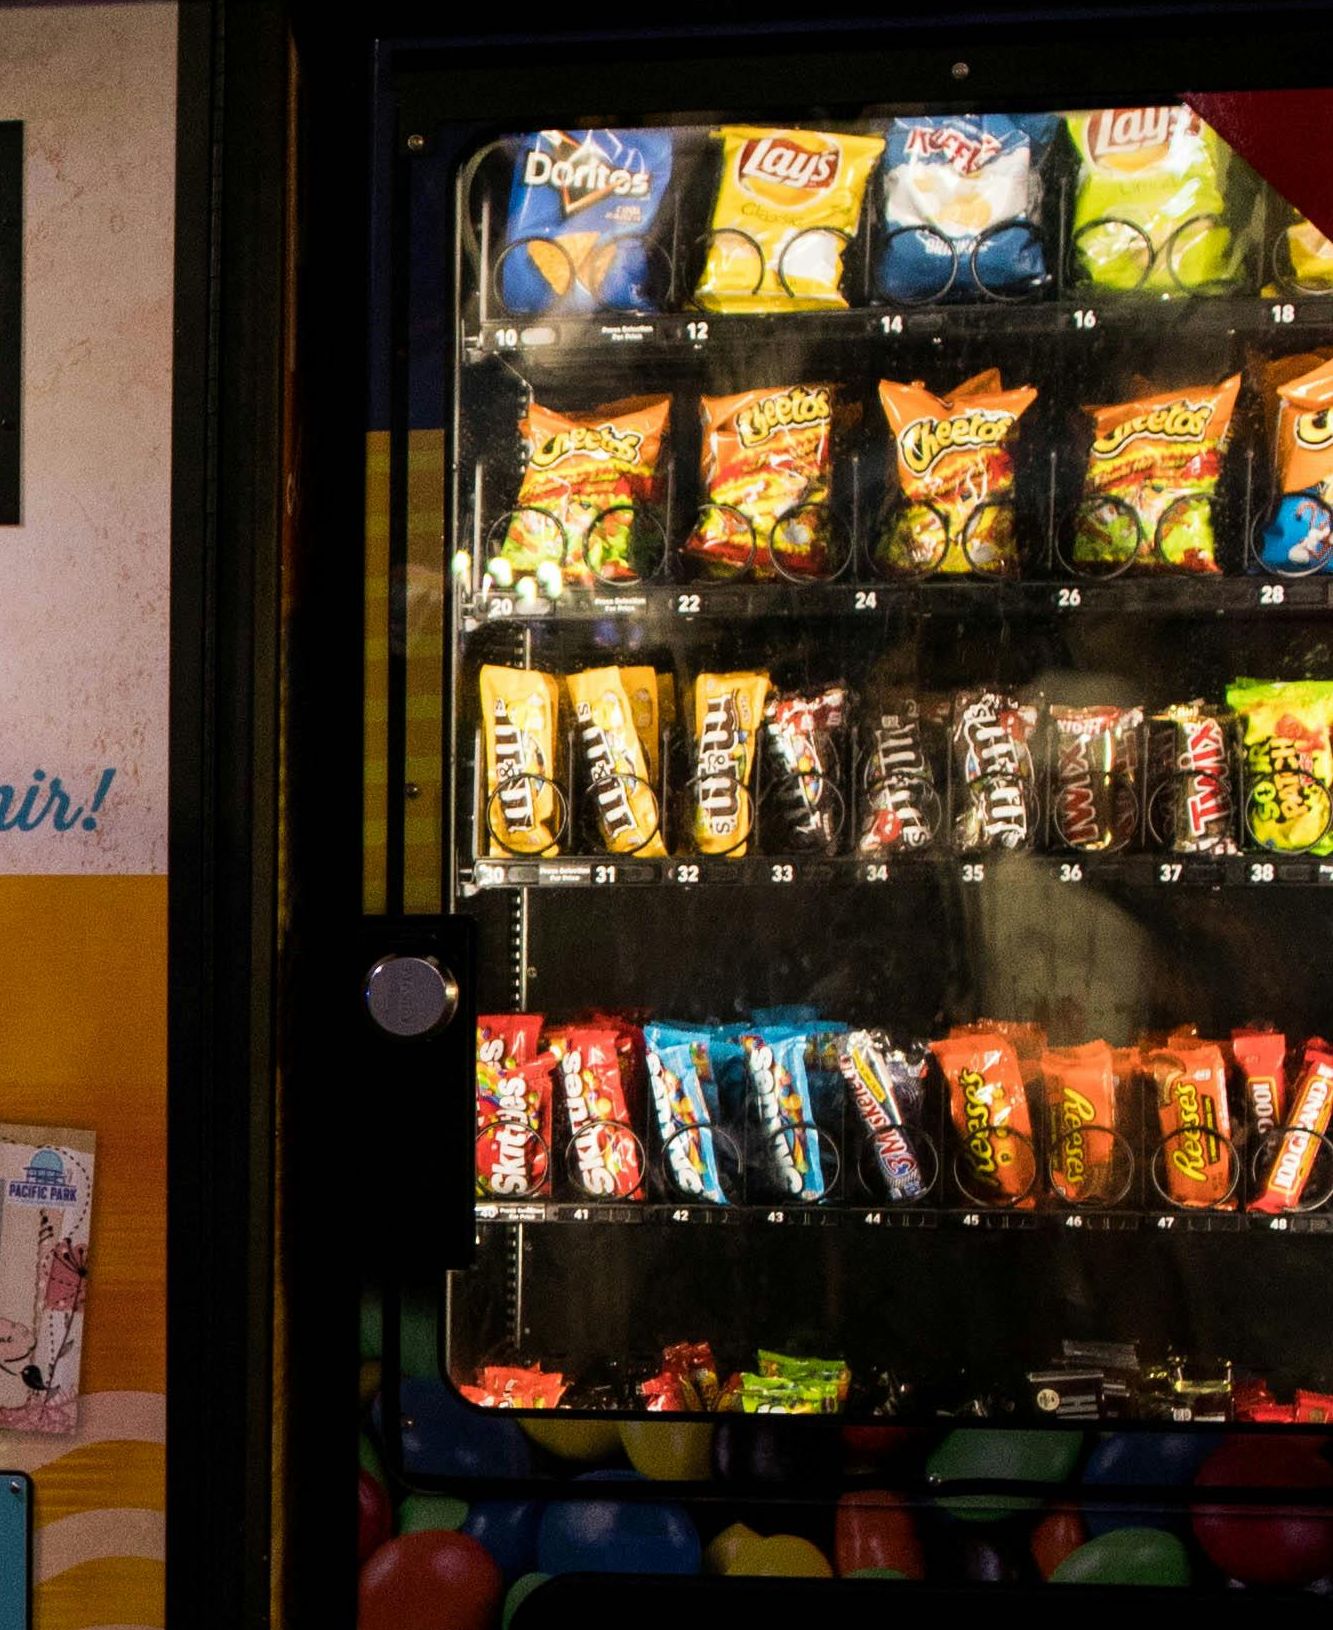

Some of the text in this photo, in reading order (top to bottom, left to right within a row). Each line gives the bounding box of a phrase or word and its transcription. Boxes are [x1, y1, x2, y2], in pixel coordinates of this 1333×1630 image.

[524, 150, 650, 196] Doritos
[1074, 310, 1097, 329] 16
[1272, 304, 1295, 324] 18
[687, 321, 709, 340] 12
[881, 315, 903, 334] 14
[495, 328, 518, 347] 10
[737, 387, 830, 448] Cheetos
[898, 410, 1017, 476] Cheetos
[678, 594, 701, 613] 22
[854, 591, 877, 610] 24
[1058, 588, 1081, 607] 26
[1261, 585, 1285, 605] 28
[595, 865, 616, 883] 31
[677, 865, 700, 882] 32
[771, 865, 794, 882] 33
[866, 865, 889, 882] 34
[962, 865, 984, 882] 35
[1059, 864, 1083, 882] 36
[1159, 863, 1183, 882] 37
[1250, 863, 1275, 882] 38
[1171, 1082, 1208, 1182] Reese's
[8, 1182, 77, 1202] PACIFIC PARK
[574, 1208, 589, 1220] 41
[672, 1209, 689, 1221] 42
[767, 1211, 784, 1223] 43
[864, 1213, 881, 1225] 44
[962, 1214, 979, 1226] 45
[1065, 1216, 1083, 1227] 46
[1156, 1216, 1175, 1228] 47
[1269, 1218, 1288, 1230] 48
